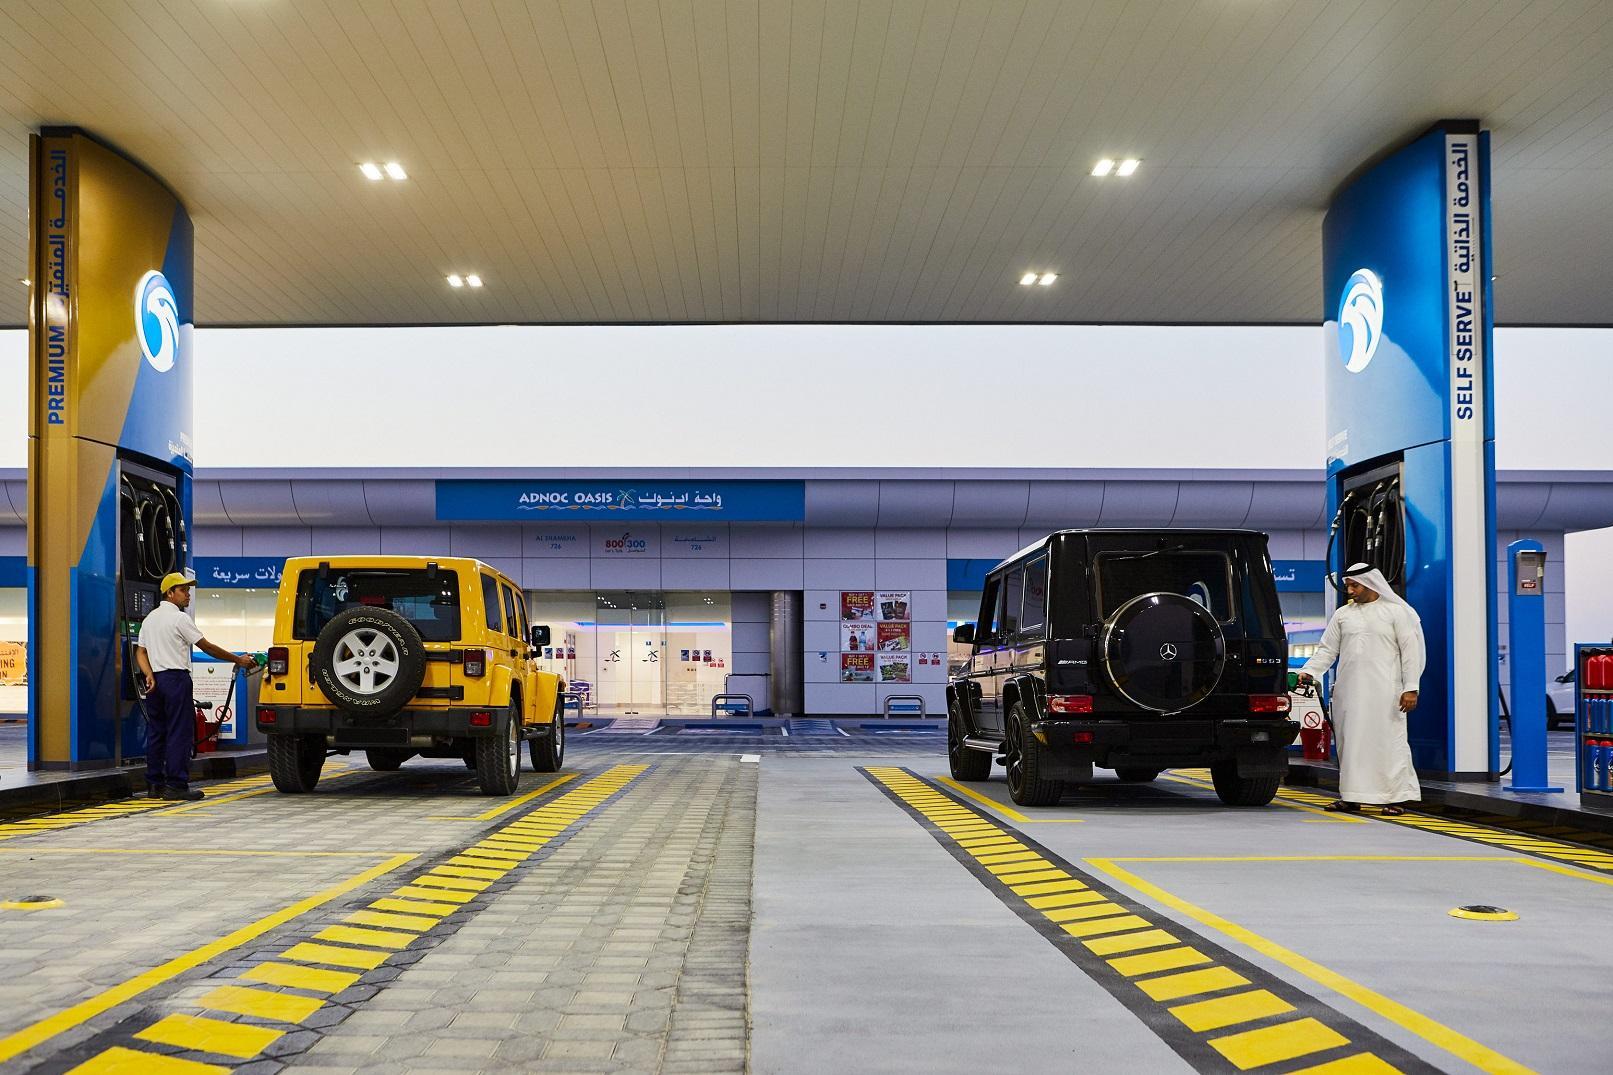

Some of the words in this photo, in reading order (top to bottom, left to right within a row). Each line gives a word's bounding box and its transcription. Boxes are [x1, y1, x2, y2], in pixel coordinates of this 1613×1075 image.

[1451, 143, 1470, 208] الخدمة
[49, 150, 67, 229] الخدمة
[1453, 213, 1475, 273] الذاتية
[1456, 291, 1473, 361] SERVE
[48, 325, 65, 424] PREMIUM
[1456, 367, 1473, 420] SELF
[519, 492, 569, 503] ADNOC
[574, 492, 613, 503] OASIS
[694, 490, 722, 507] واحة
[605, 539, 624, 549] 800
[626, 539, 646, 549] 300
[212, 566, 250, 583] سريعة
[846, 596, 869, 604] FREE
[847, 658, 869, 666] FREE
